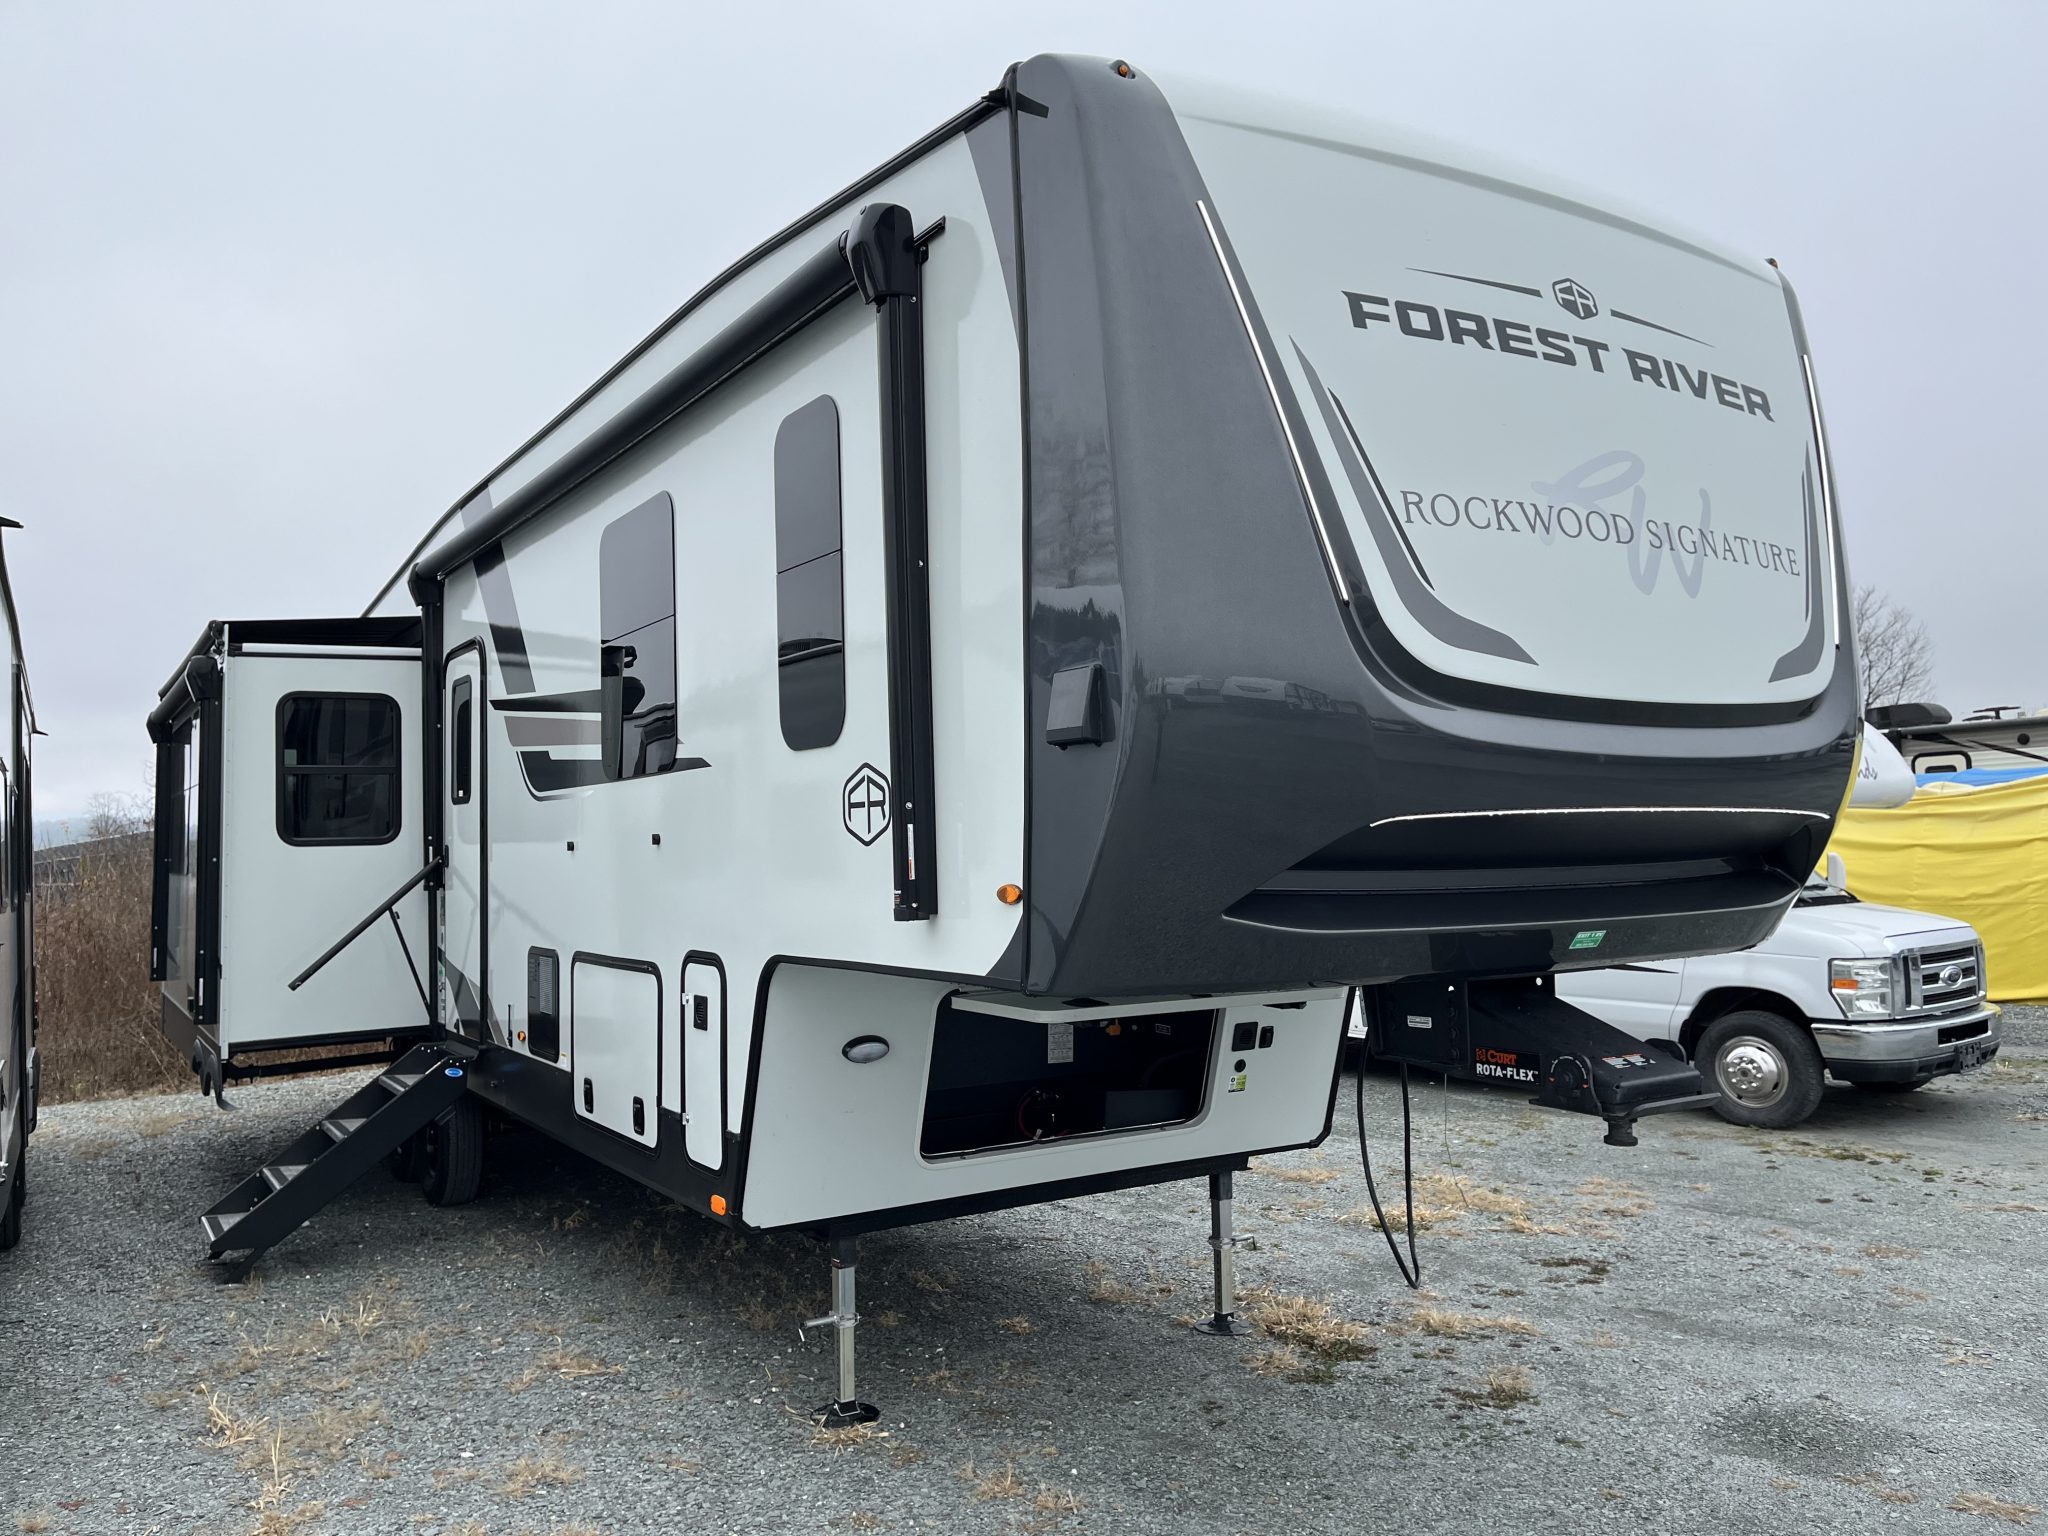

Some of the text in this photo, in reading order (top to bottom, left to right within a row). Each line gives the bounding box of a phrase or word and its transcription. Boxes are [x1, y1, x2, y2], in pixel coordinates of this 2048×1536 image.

[1341, 290, 1776, 423] FOREST RIVER
[1400, 490, 1800, 577] ROCKWOOD SIGNATURE
